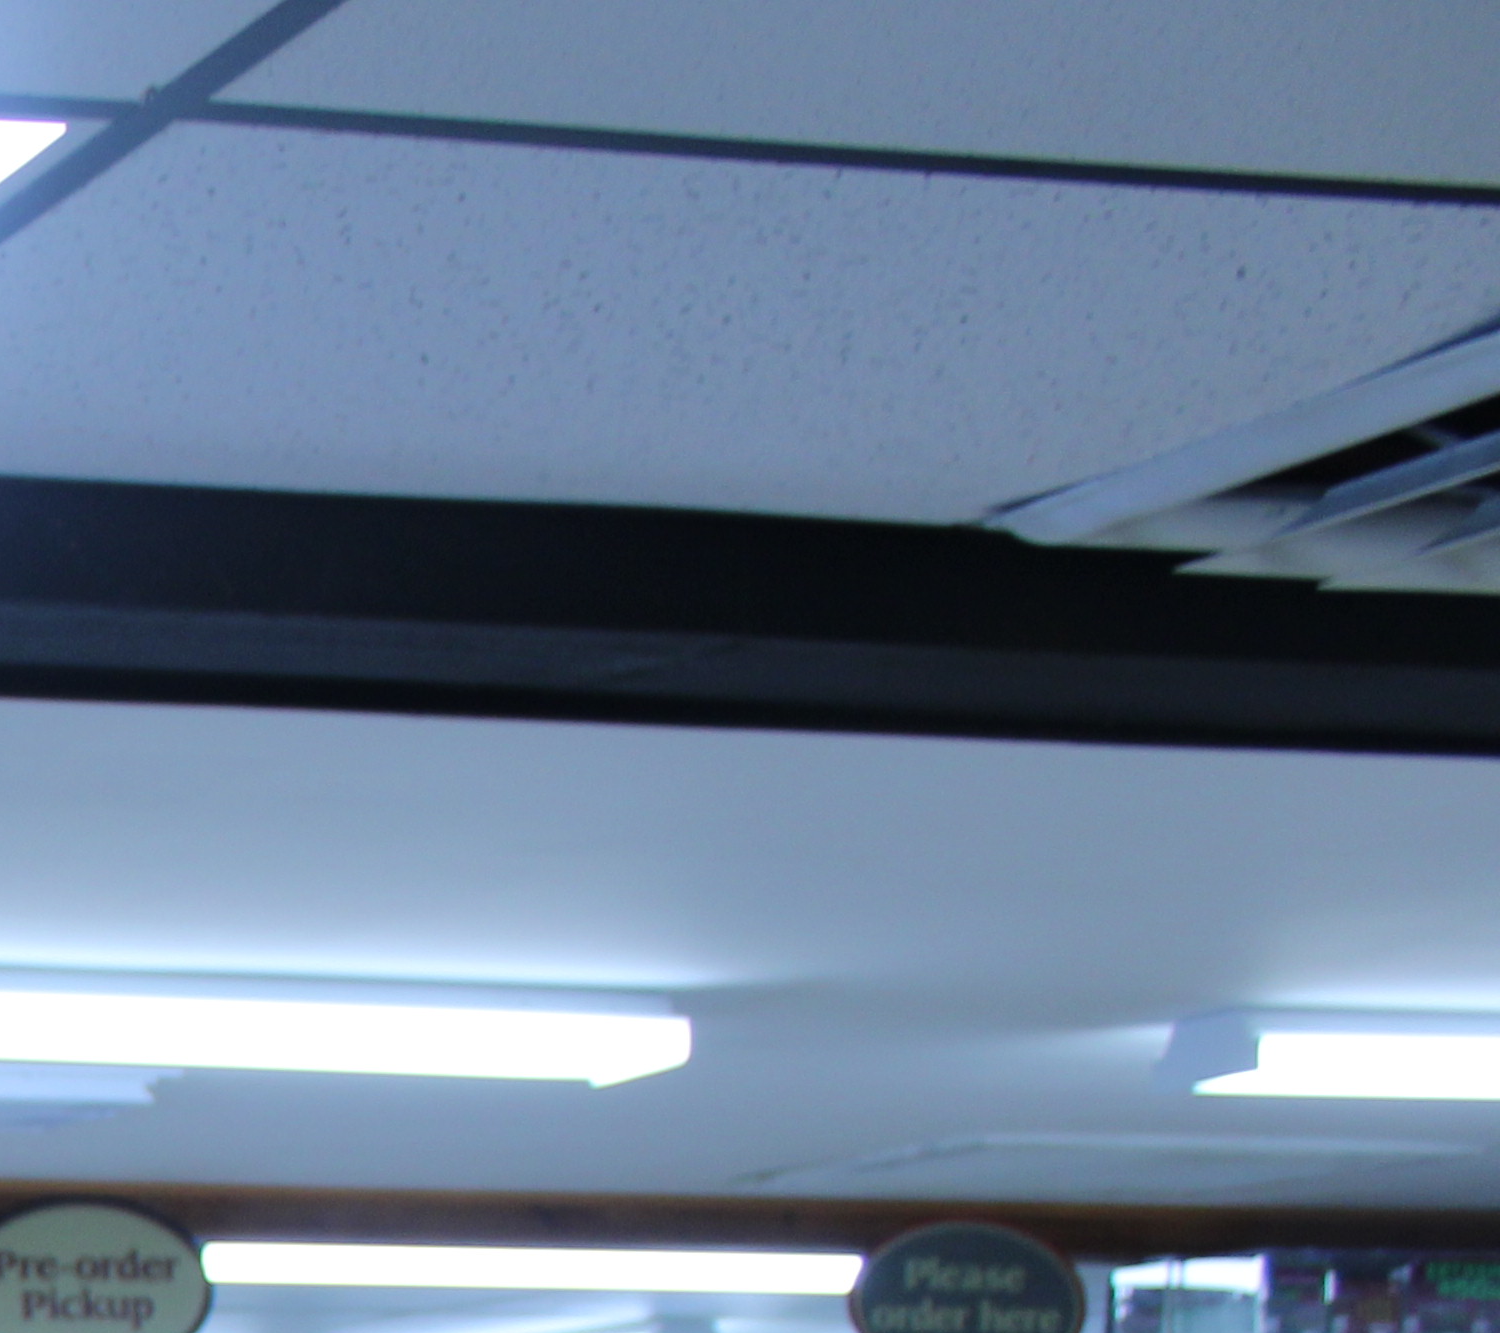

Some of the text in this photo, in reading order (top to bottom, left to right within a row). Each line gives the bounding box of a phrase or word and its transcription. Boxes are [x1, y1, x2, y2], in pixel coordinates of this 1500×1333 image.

[903, 1256, 1027, 1292] Please
[21, 1289, 154, 1331] Pickup
[872, 1298, 965, 1331] order
